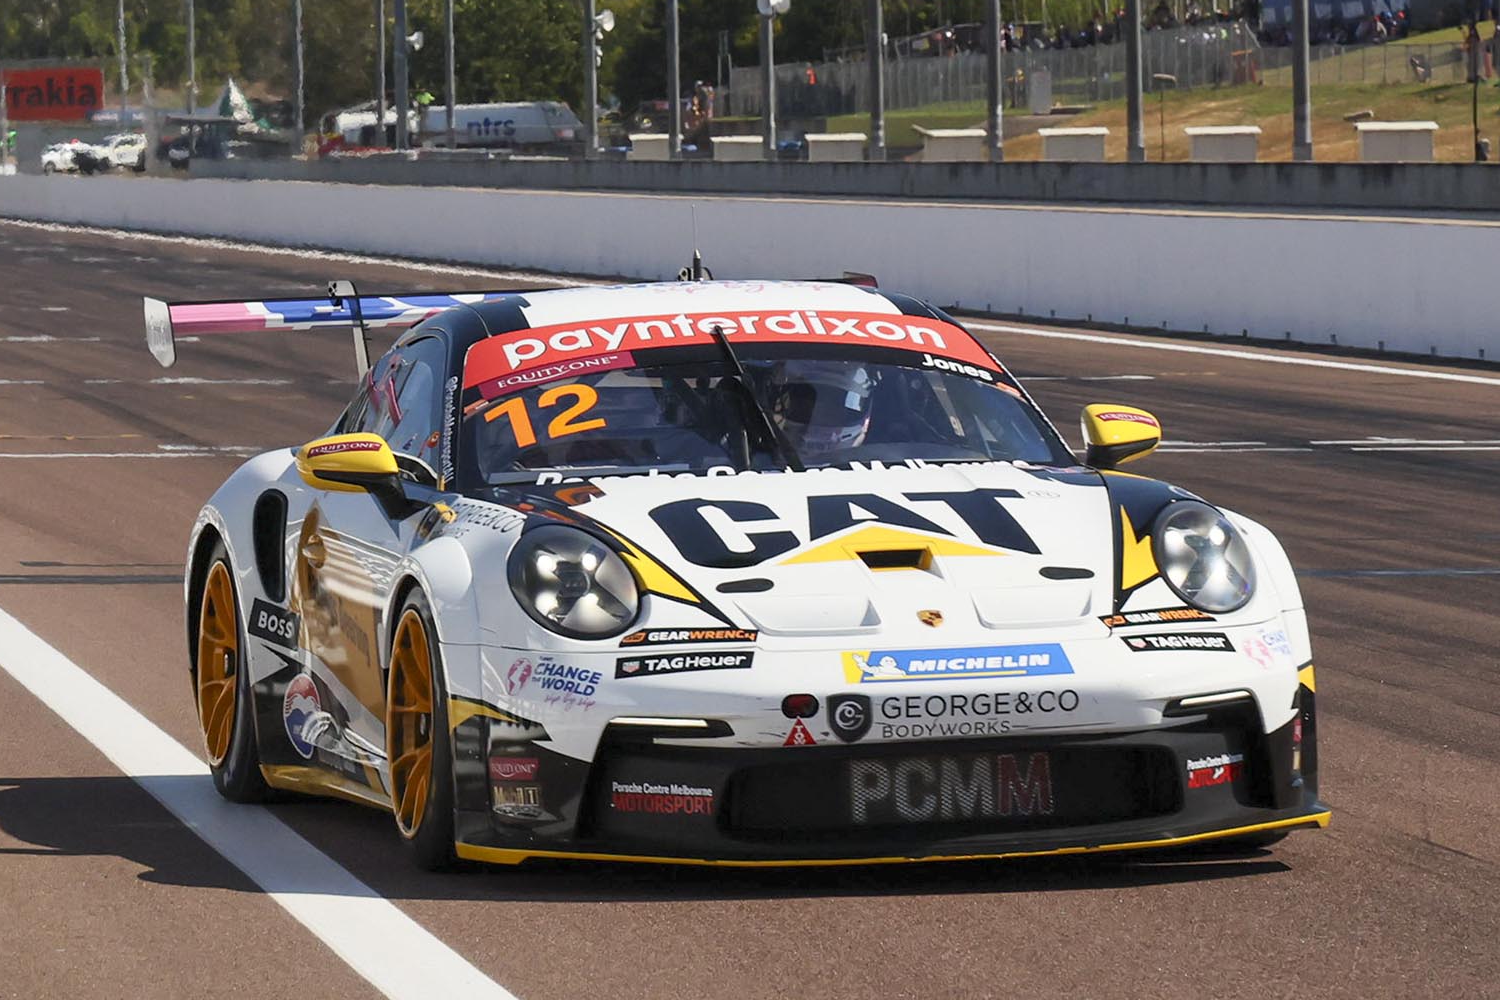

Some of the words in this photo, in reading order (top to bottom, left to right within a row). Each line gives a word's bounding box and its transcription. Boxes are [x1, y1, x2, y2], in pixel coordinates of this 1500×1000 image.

[502, 310, 948, 370] paynterdixon
[922, 354, 993, 381] Jones
[484, 383, 607, 448] 12
[648, 487, 1042, 568] CAT
[257, 610, 295, 639] BOSS
[1125, 608, 1211, 624] GEARWRENC
[534, 662, 602, 685] CHANGE
[908, 653, 1050, 672] MICHELIN
[540, 676, 596, 697] WORLD
[881, 689, 1080, 720] GEORGE&CO
[882, 720, 1011, 739] BODYWORKS
[612, 781, 642, 793] Porsche
[643, 782, 670, 795] Centre
[670, 784, 713, 797] Melbourne
[850, 752, 1054, 823] PCMM
[611, 793, 714, 815] MOTORSPORT
